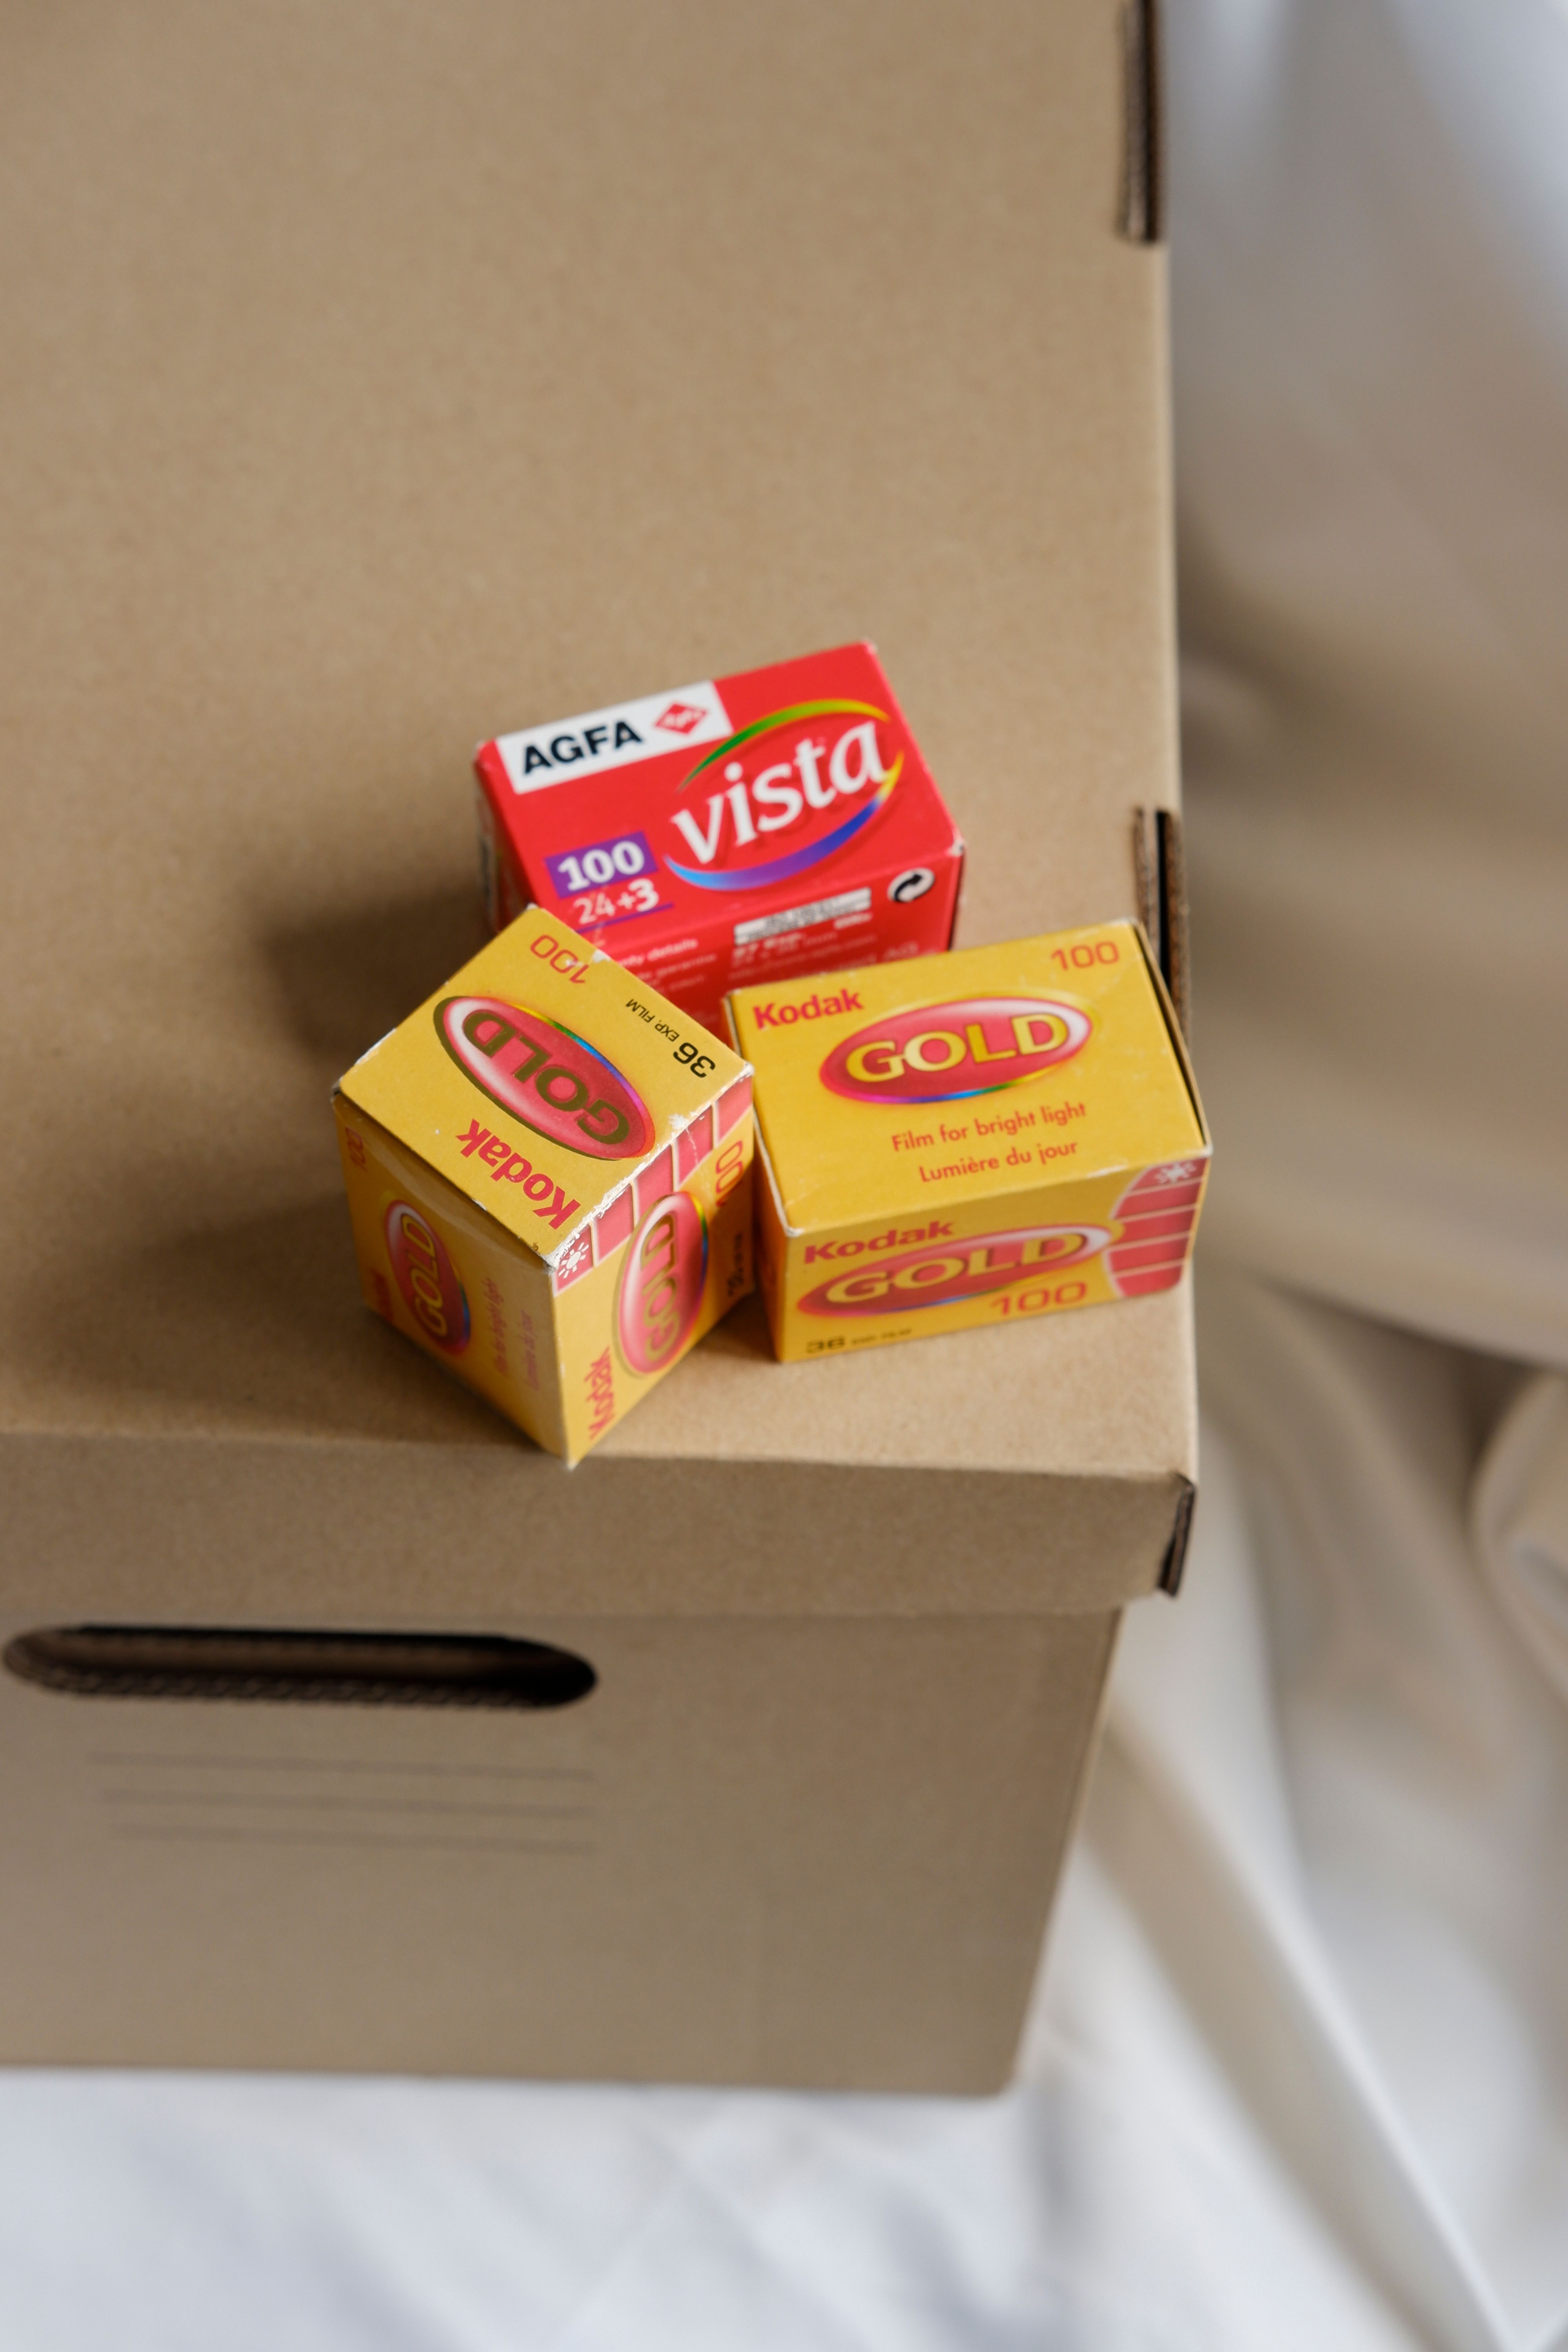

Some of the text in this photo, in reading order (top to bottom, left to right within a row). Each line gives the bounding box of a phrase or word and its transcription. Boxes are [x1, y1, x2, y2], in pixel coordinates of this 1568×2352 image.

[524, 720, 642, 775] AGFA
[670, 720, 891, 864] vista
[557, 840, 645, 891] 100
[572, 878, 660, 925] 24+3
[530, 934, 590, 985] 100
[1051, 941, 1120, 971] 100
[753, 989, 865, 1031] Kodak
[626, 999, 715, 1078] 36 EXP. FILM
[846, 1013, 1069, 1083] GOLD
[463, 1008, 630, 1145] GOLD
[891, 1102, 1086, 1152] Film for bright light
[456, 1118, 581, 1229] Kodak
[918, 1141, 1078, 1183] Lumière du jour
[804, 1221, 955, 1264] Kodak
[825, 1233, 1087, 1303] GOLD
[401, 1212, 447, 1336] GOLD
[640, 1214, 680, 1361] GOLD
[991, 1281, 1087, 1317] 100
[584, 1345, 616, 1440] Kodak
